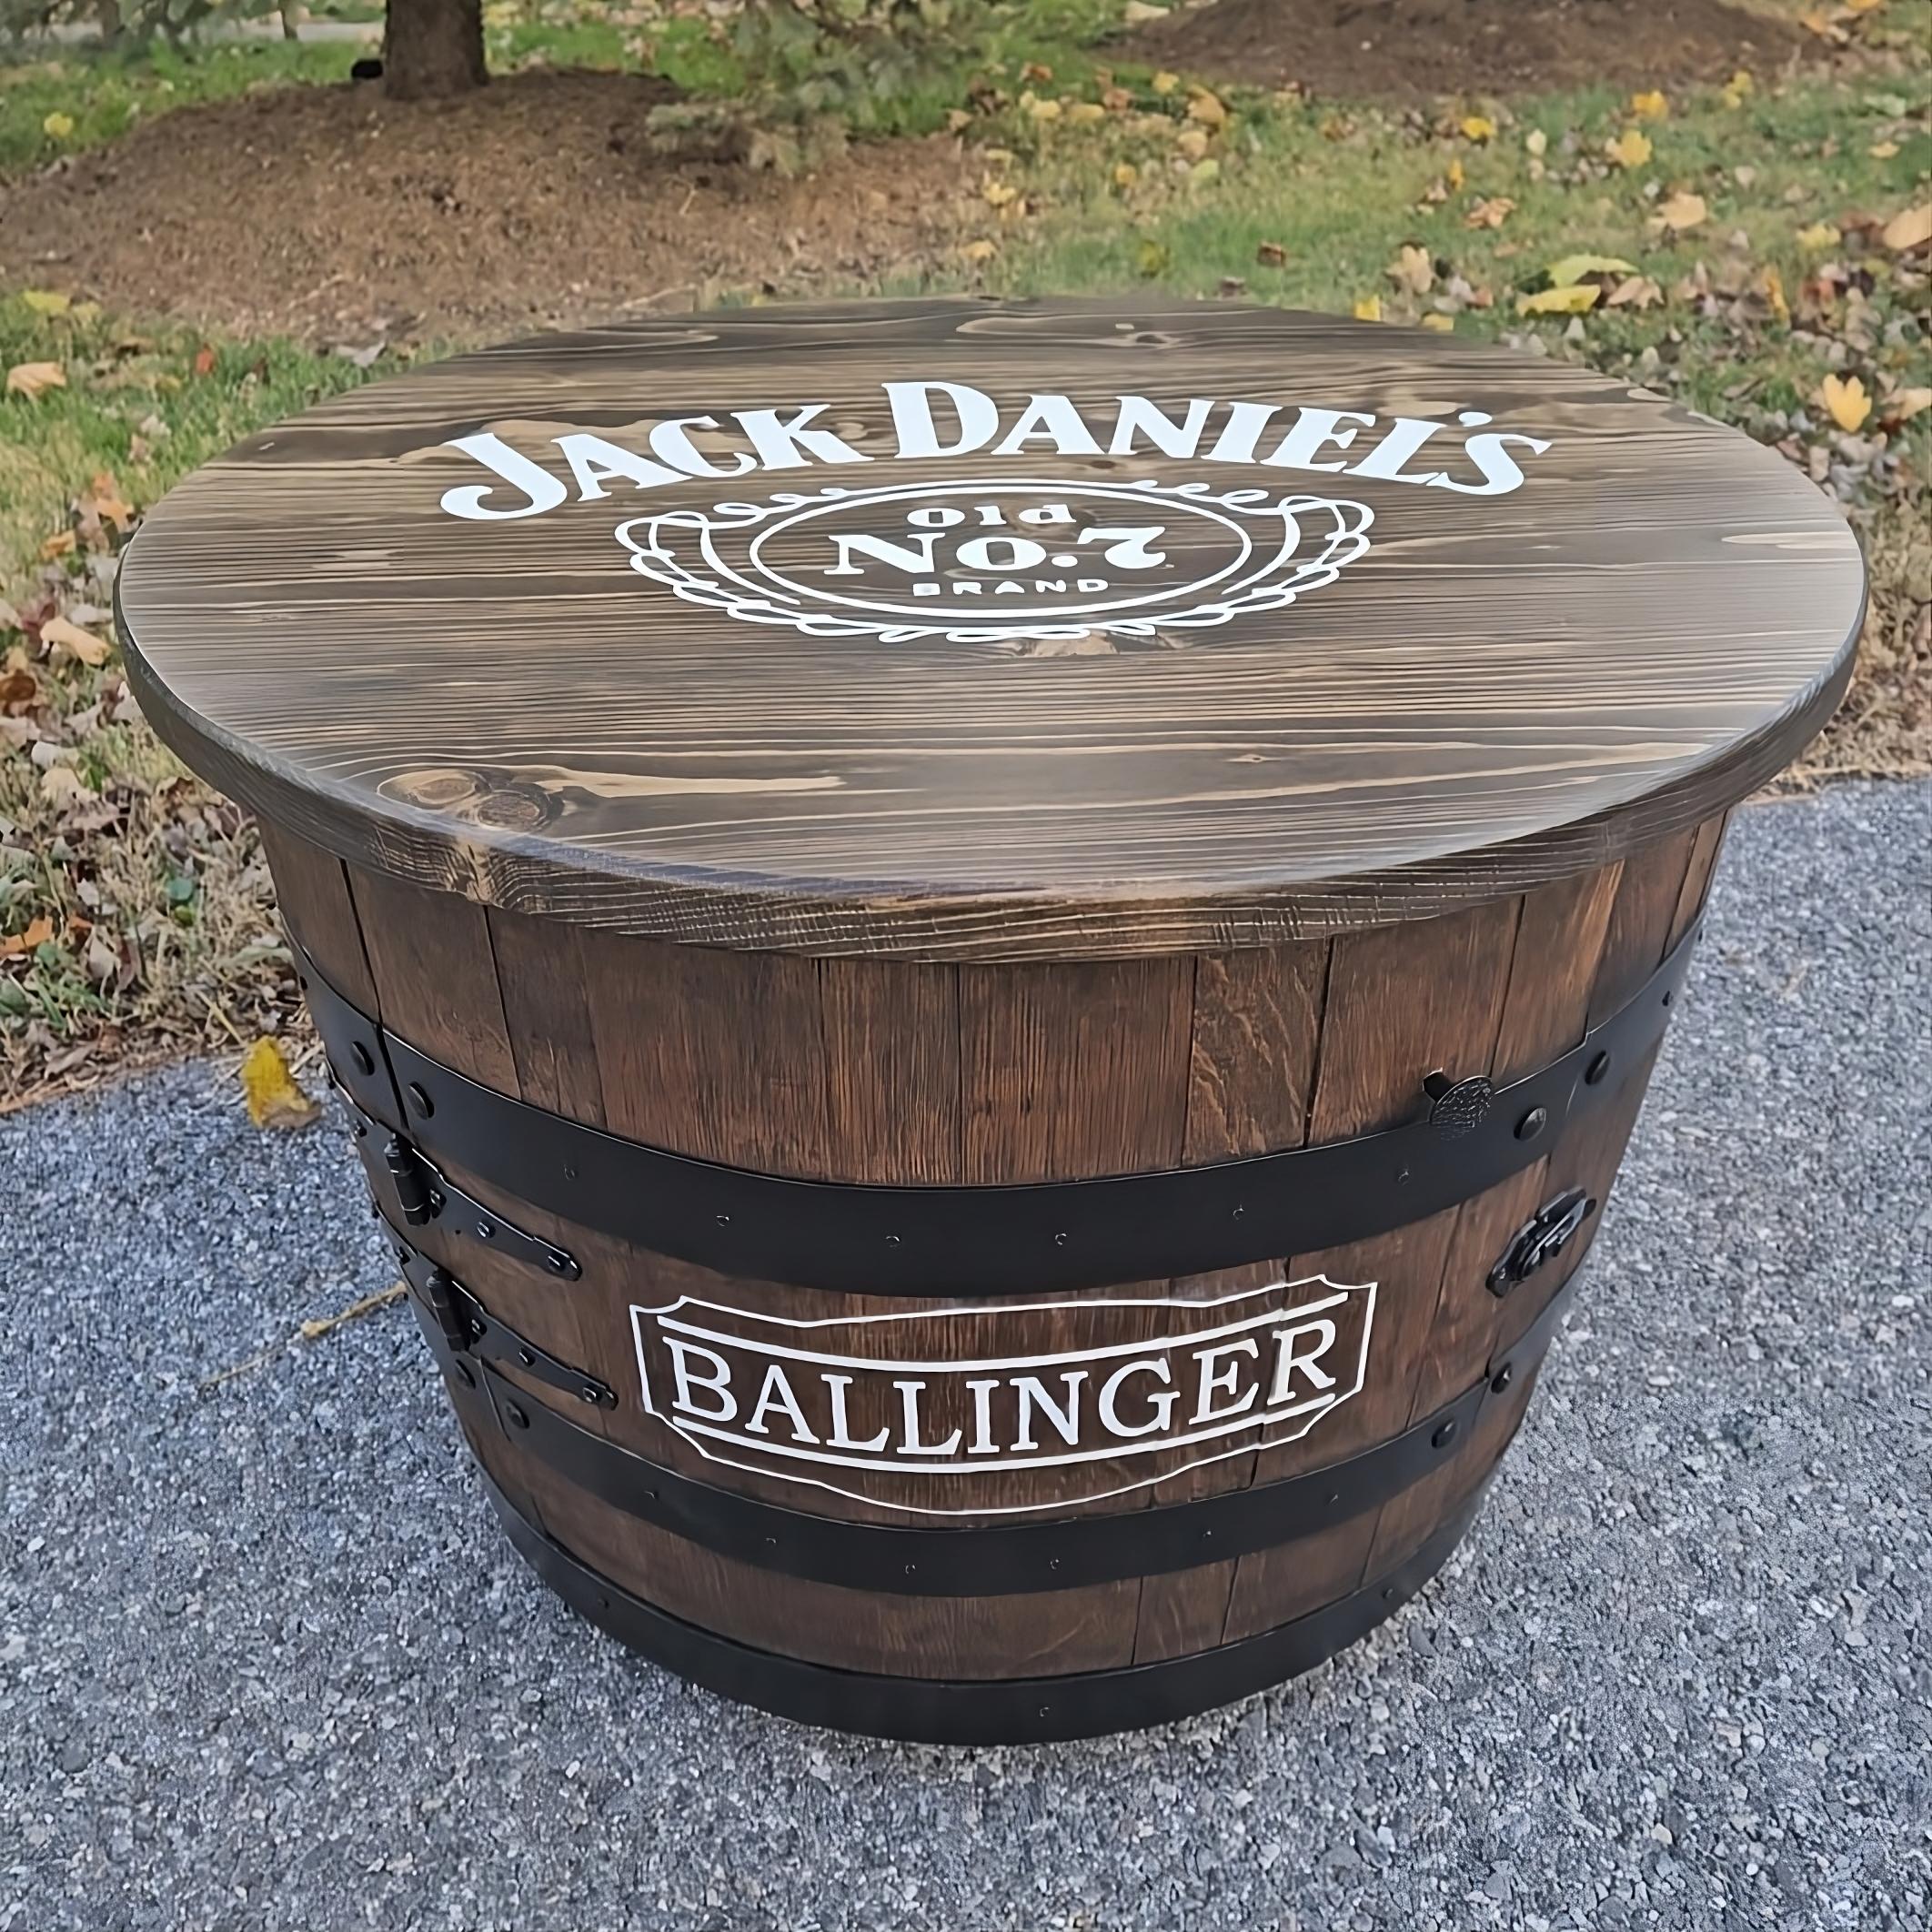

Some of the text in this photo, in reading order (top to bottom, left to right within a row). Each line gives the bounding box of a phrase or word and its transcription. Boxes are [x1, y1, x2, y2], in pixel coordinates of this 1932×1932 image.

[440, 381, 1553, 520] JACK DANIEL'S
[662, 1318, 1337, 1455] BALLINGER
